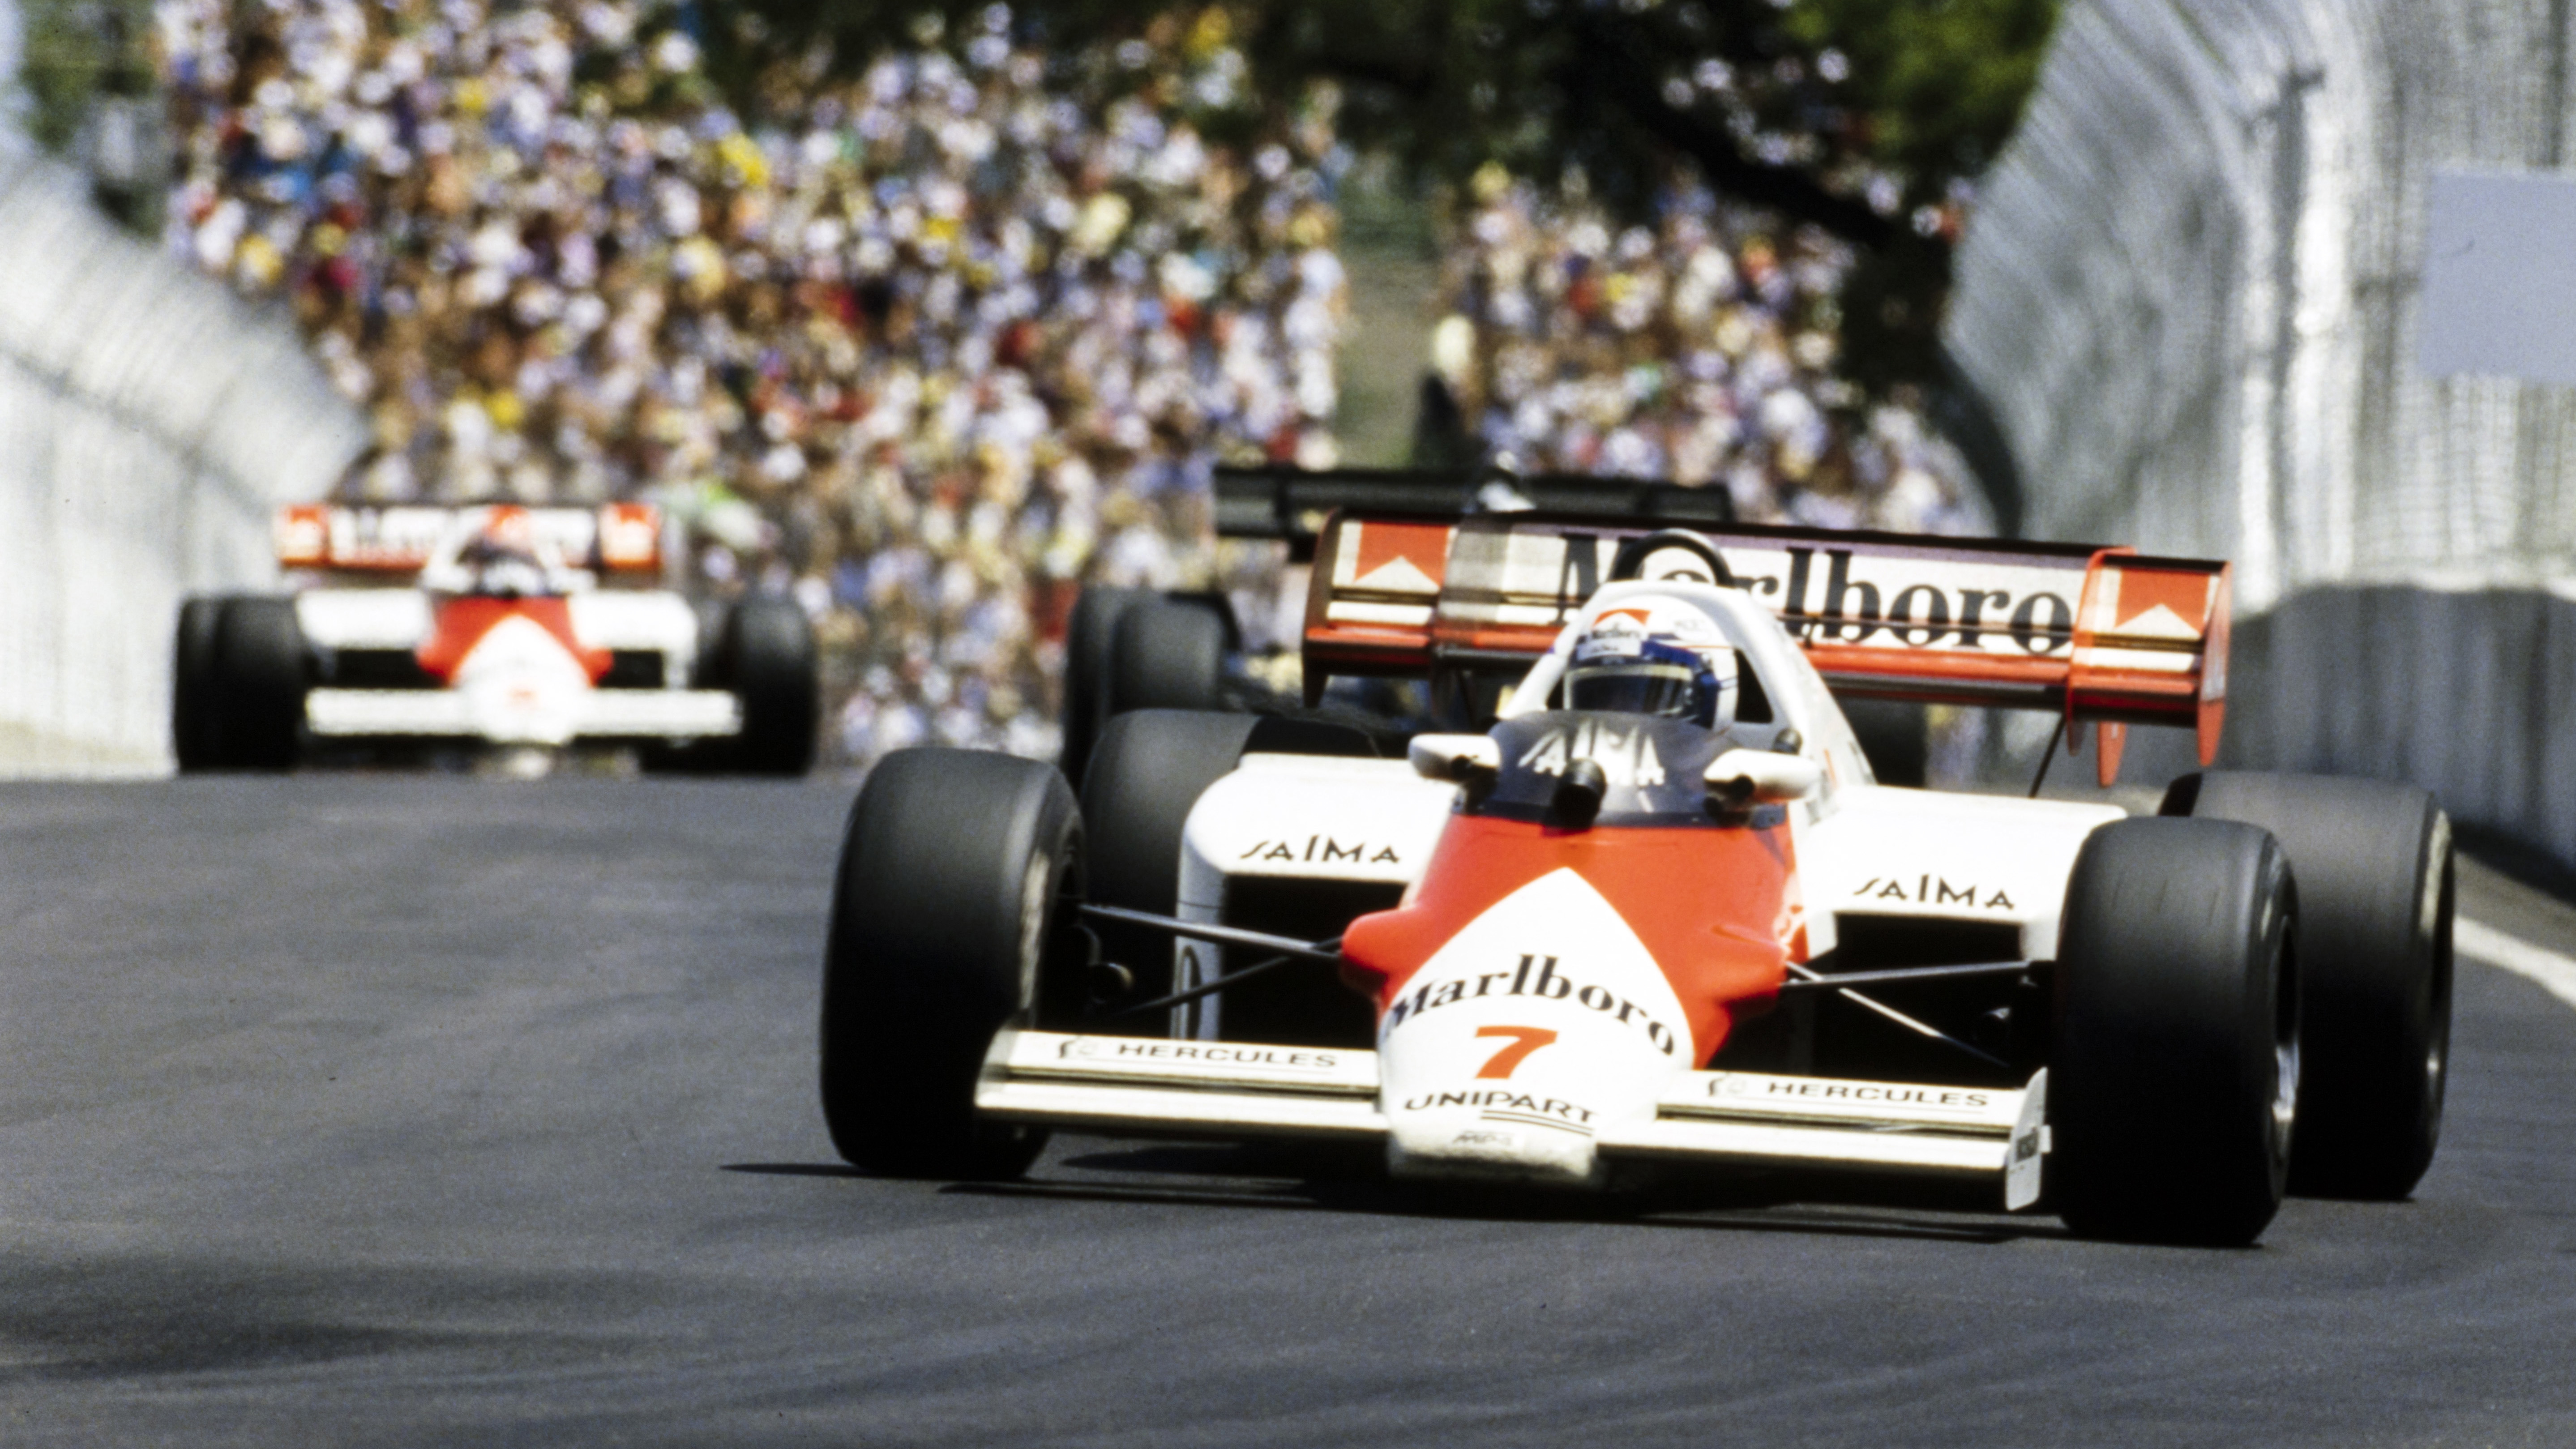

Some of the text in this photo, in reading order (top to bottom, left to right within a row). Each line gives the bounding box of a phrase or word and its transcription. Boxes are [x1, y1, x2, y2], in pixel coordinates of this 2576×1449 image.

[1240, 834, 1401, 863] SAIMA
[1853, 873, 2015, 910] SAIMA
[1389, 953, 1673, 1055] Marlboro
[1119, 1043, 1337, 1067] HERCULES
[1475, 1026, 1558, 1079] 7
[1404, 1090, 1598, 1122] UNIPART
[1768, 1081, 1989, 1106] HERCULES
